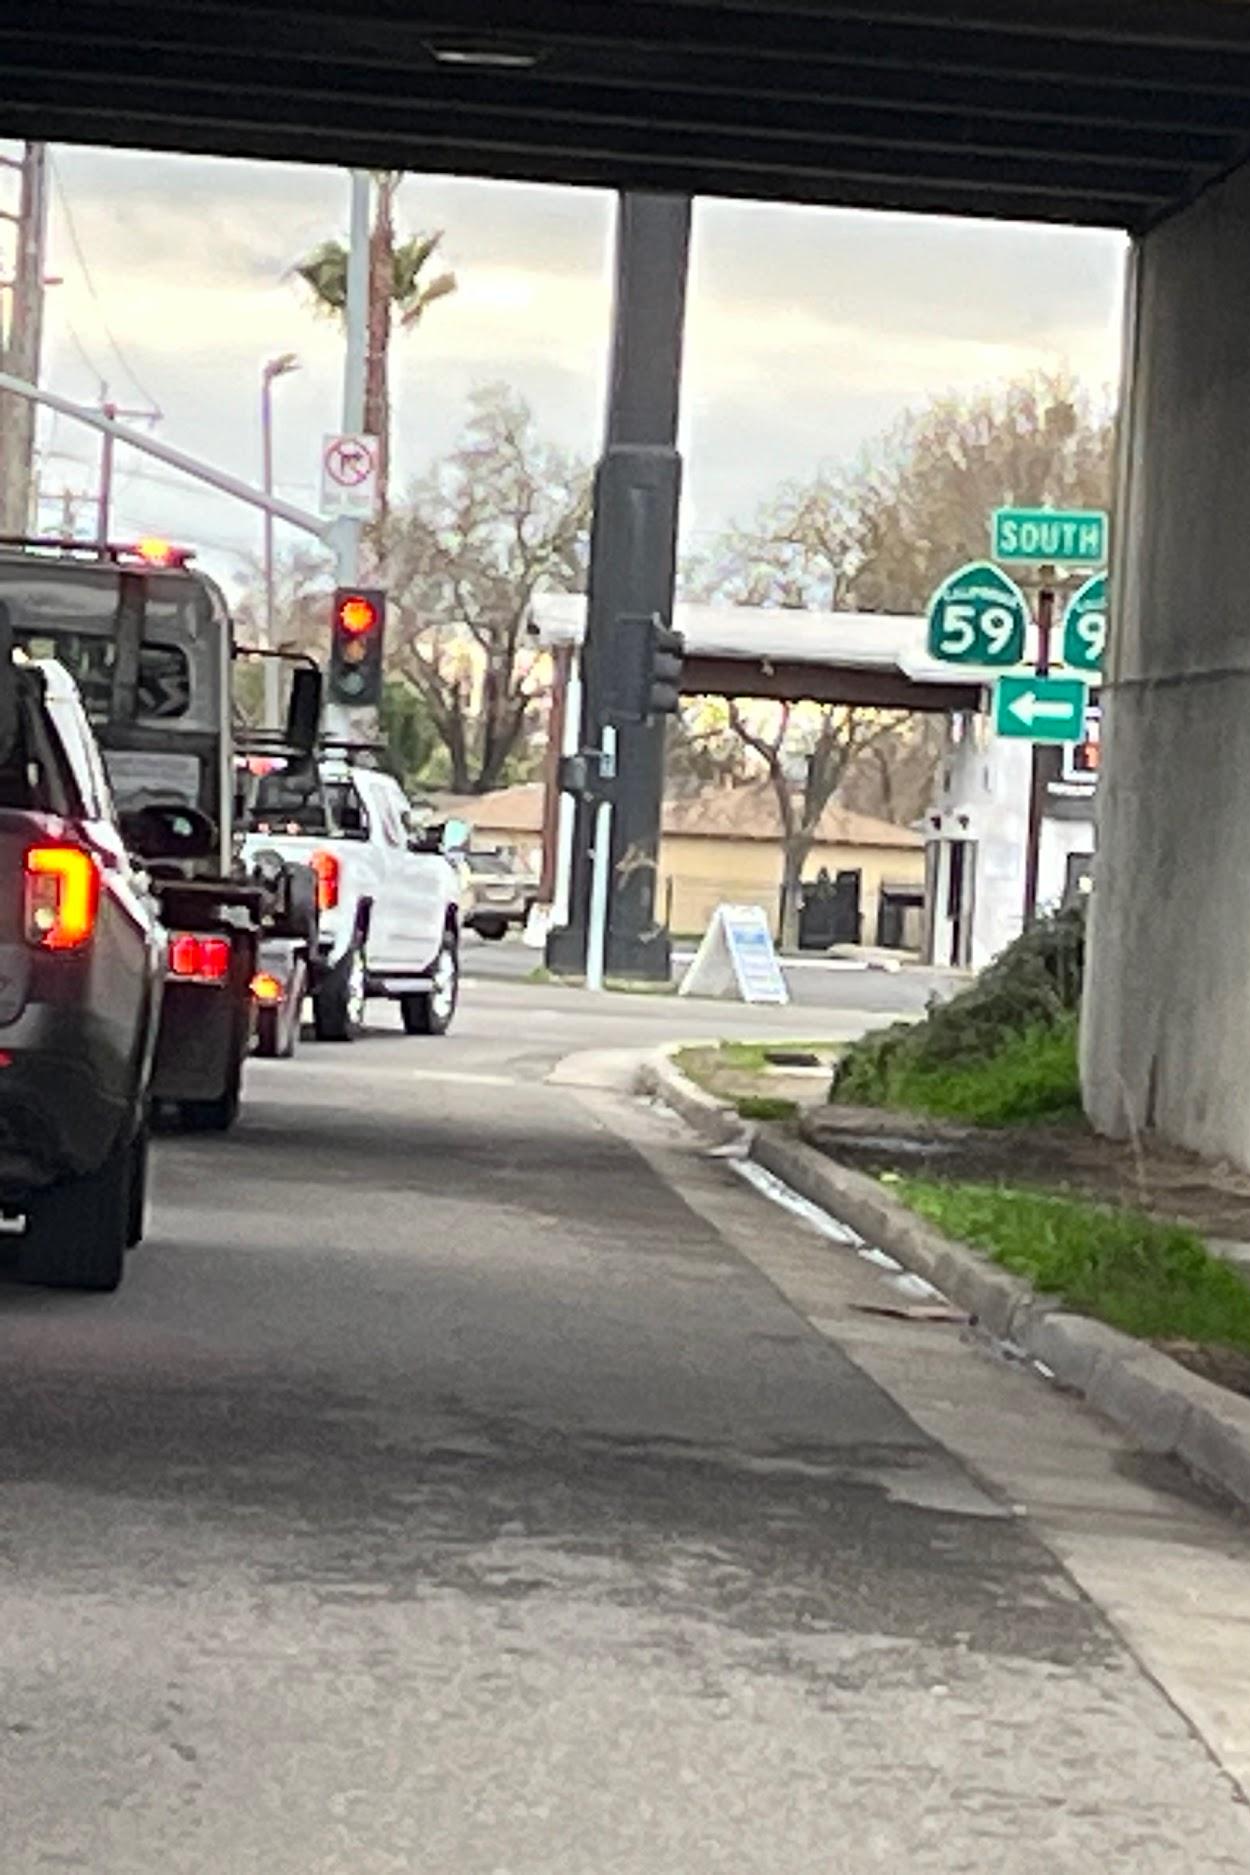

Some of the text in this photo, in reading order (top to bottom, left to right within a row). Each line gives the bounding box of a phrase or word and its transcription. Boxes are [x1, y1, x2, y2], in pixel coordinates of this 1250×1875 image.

[1001, 520, 1099, 555] SOUTH
[940, 604, 1014, 654] 59
[1077, 612, 1106, 660] 9
